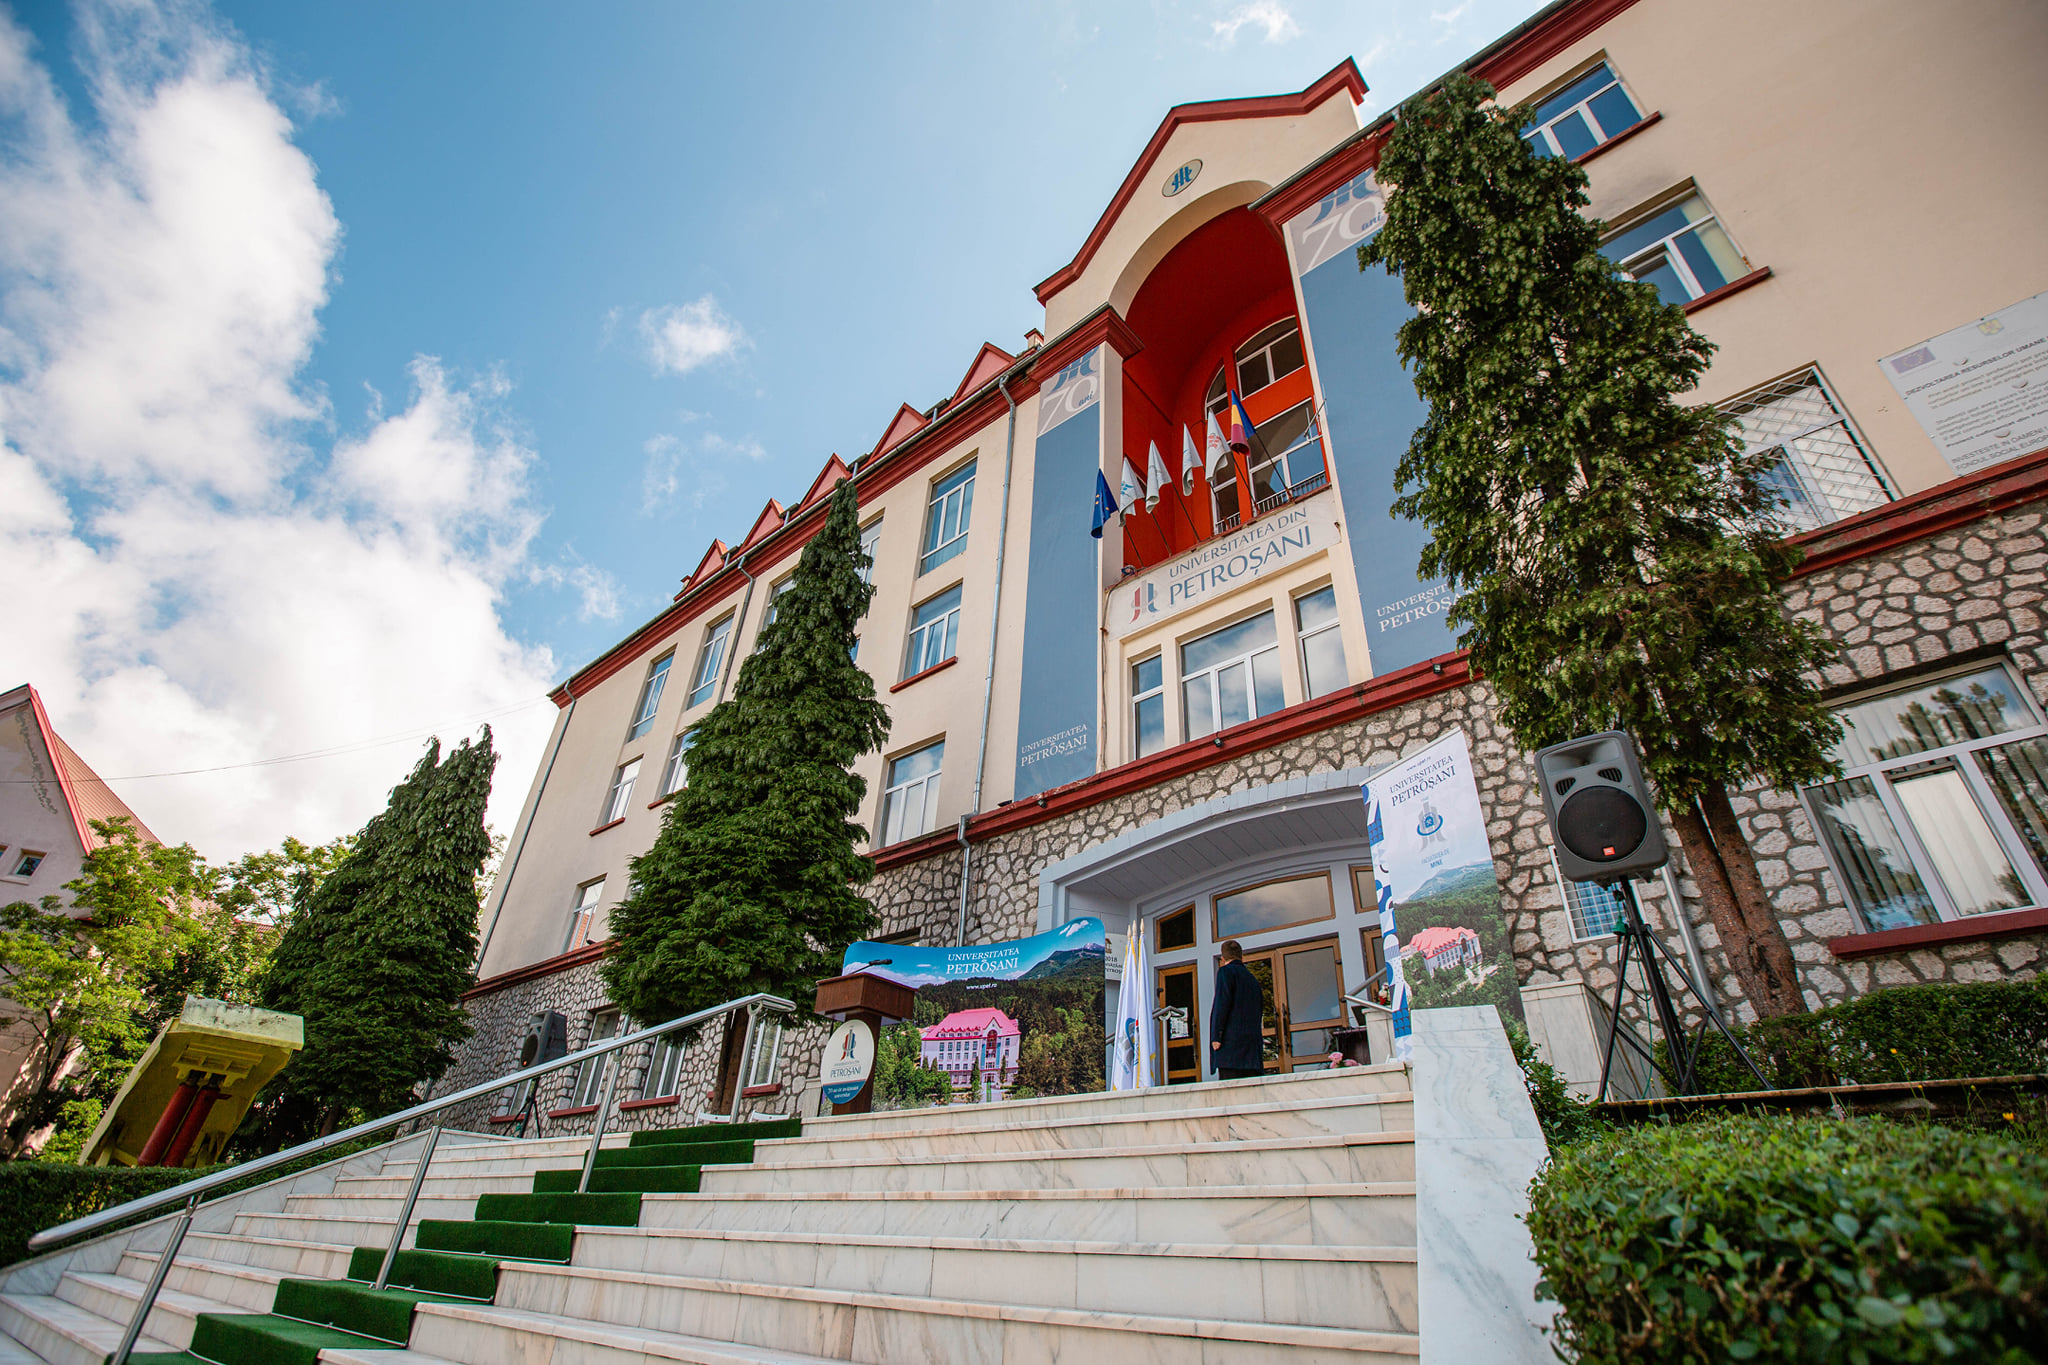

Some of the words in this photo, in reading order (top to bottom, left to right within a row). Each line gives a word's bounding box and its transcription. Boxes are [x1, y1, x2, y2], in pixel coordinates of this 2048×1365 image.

[1361, 211, 1383, 231] ani
[1041, 376, 1098, 437] 70
[1169, 523, 1275, 578] UNIVERSITATEA
[1278, 507, 1307, 529] DIN
[1170, 525, 1311, 605] PETROȘANI
[1021, 723, 1088, 754] UNIVERSITATEA
[1389, 755, 1454, 794] UNIVERSITATEA
[947, 947, 1020, 961] UNIVERSITATEA
